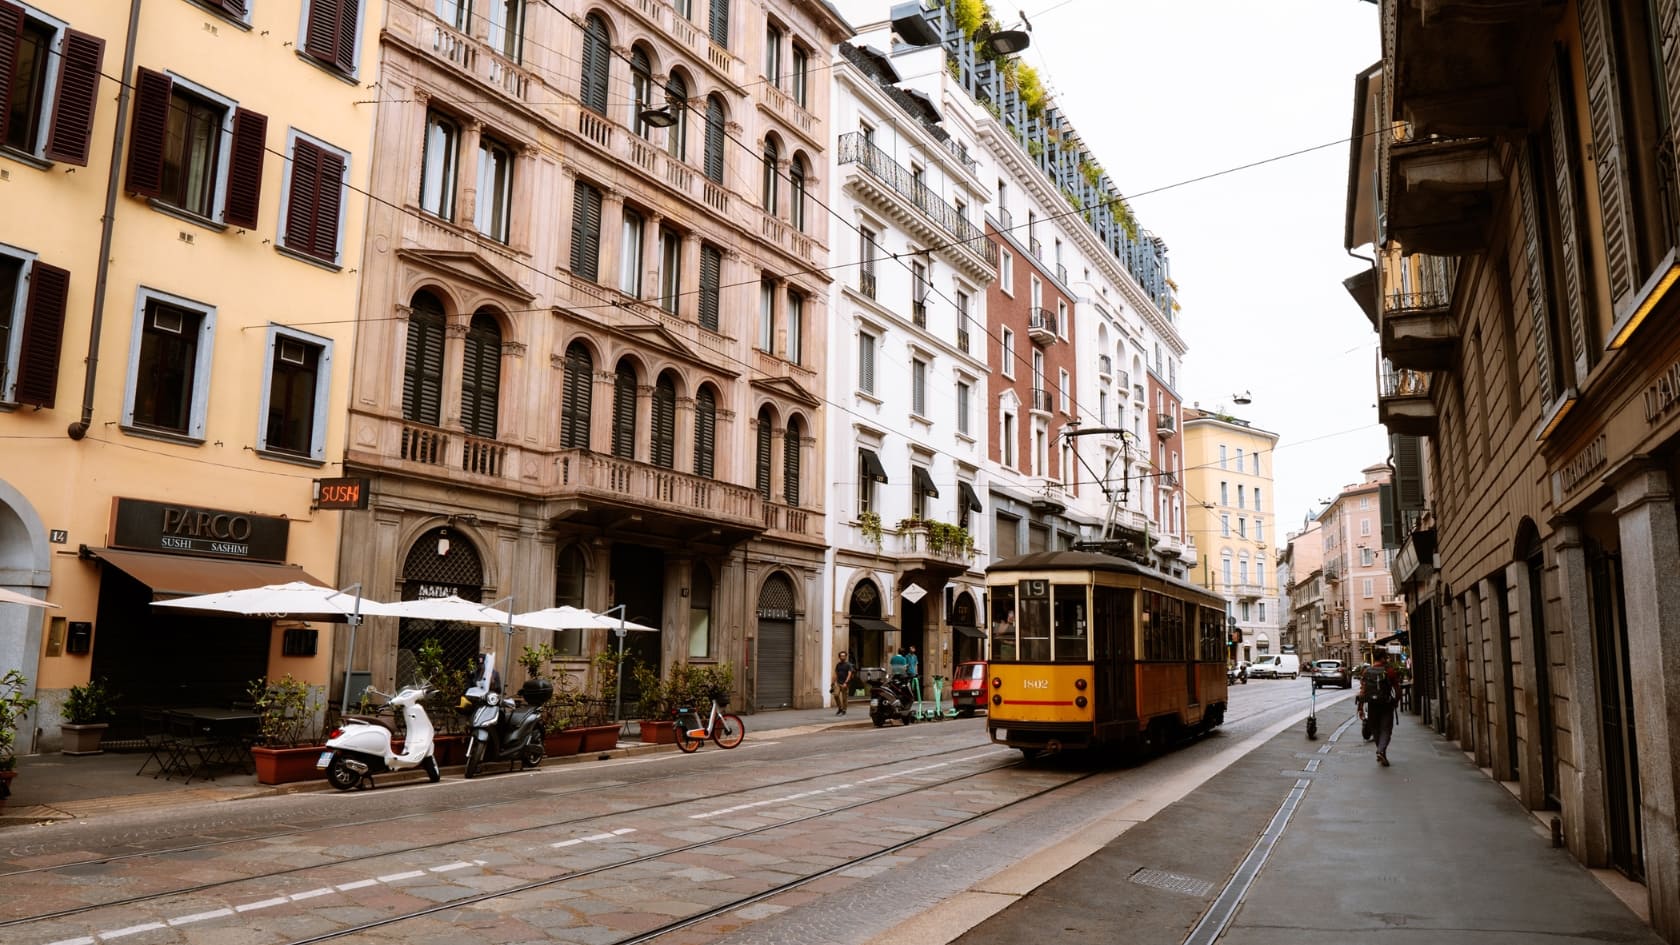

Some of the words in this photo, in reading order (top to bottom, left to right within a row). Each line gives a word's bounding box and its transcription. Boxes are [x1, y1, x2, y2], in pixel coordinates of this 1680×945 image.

[162, 507, 252, 540] PARCO
[53, 530, 65, 542] 14
[161, 537, 192, 549] SUSHI
[211, 542, 249, 555] SASHIMI
[1026, 580, 1045, 597] 19
[1023, 679, 1048, 689] 1802
